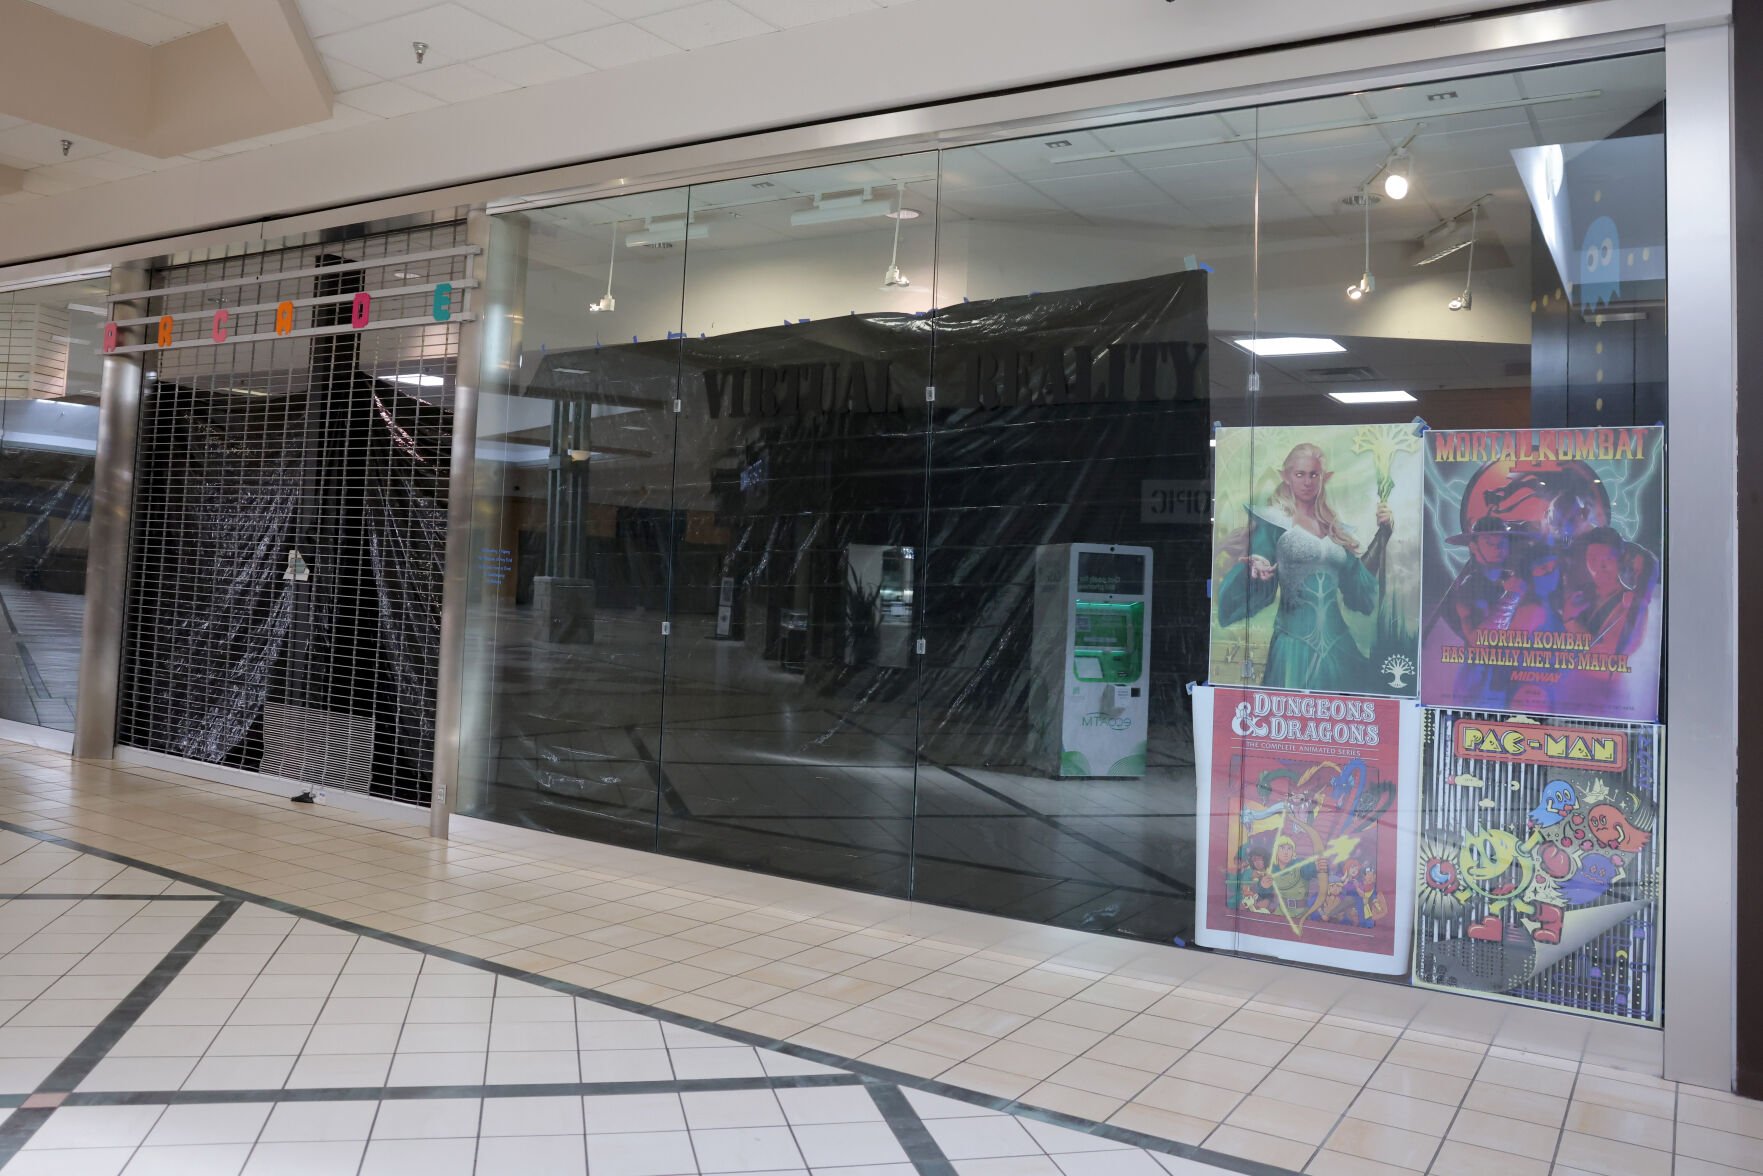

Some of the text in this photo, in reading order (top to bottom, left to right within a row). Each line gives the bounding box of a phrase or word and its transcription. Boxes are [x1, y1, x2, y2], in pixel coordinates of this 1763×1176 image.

[103, 283, 453, 352] ARCADE
[701, 342, 1208, 419] VIRTUAL REALITY
[1435, 428, 1649, 463] MORTAL KOMBAT
[1476, 629, 1592, 650] MORTAL KOMBAT
[1441, 645, 1632, 673] HAS FINALLY MET ITS MATCH.
[1510, 671, 1562, 683] MIDWAY
[1231, 701, 1380, 746] & DRAGONS
[1254, 693, 1376, 722] DUNGEONS
[1261, 742, 1296, 751] COMPLETE
[1299, 745, 1336, 755] ANIMATED
[1338, 748, 1361, 757] SERIES
[1462, 726, 1617, 763] PAC-MAN
